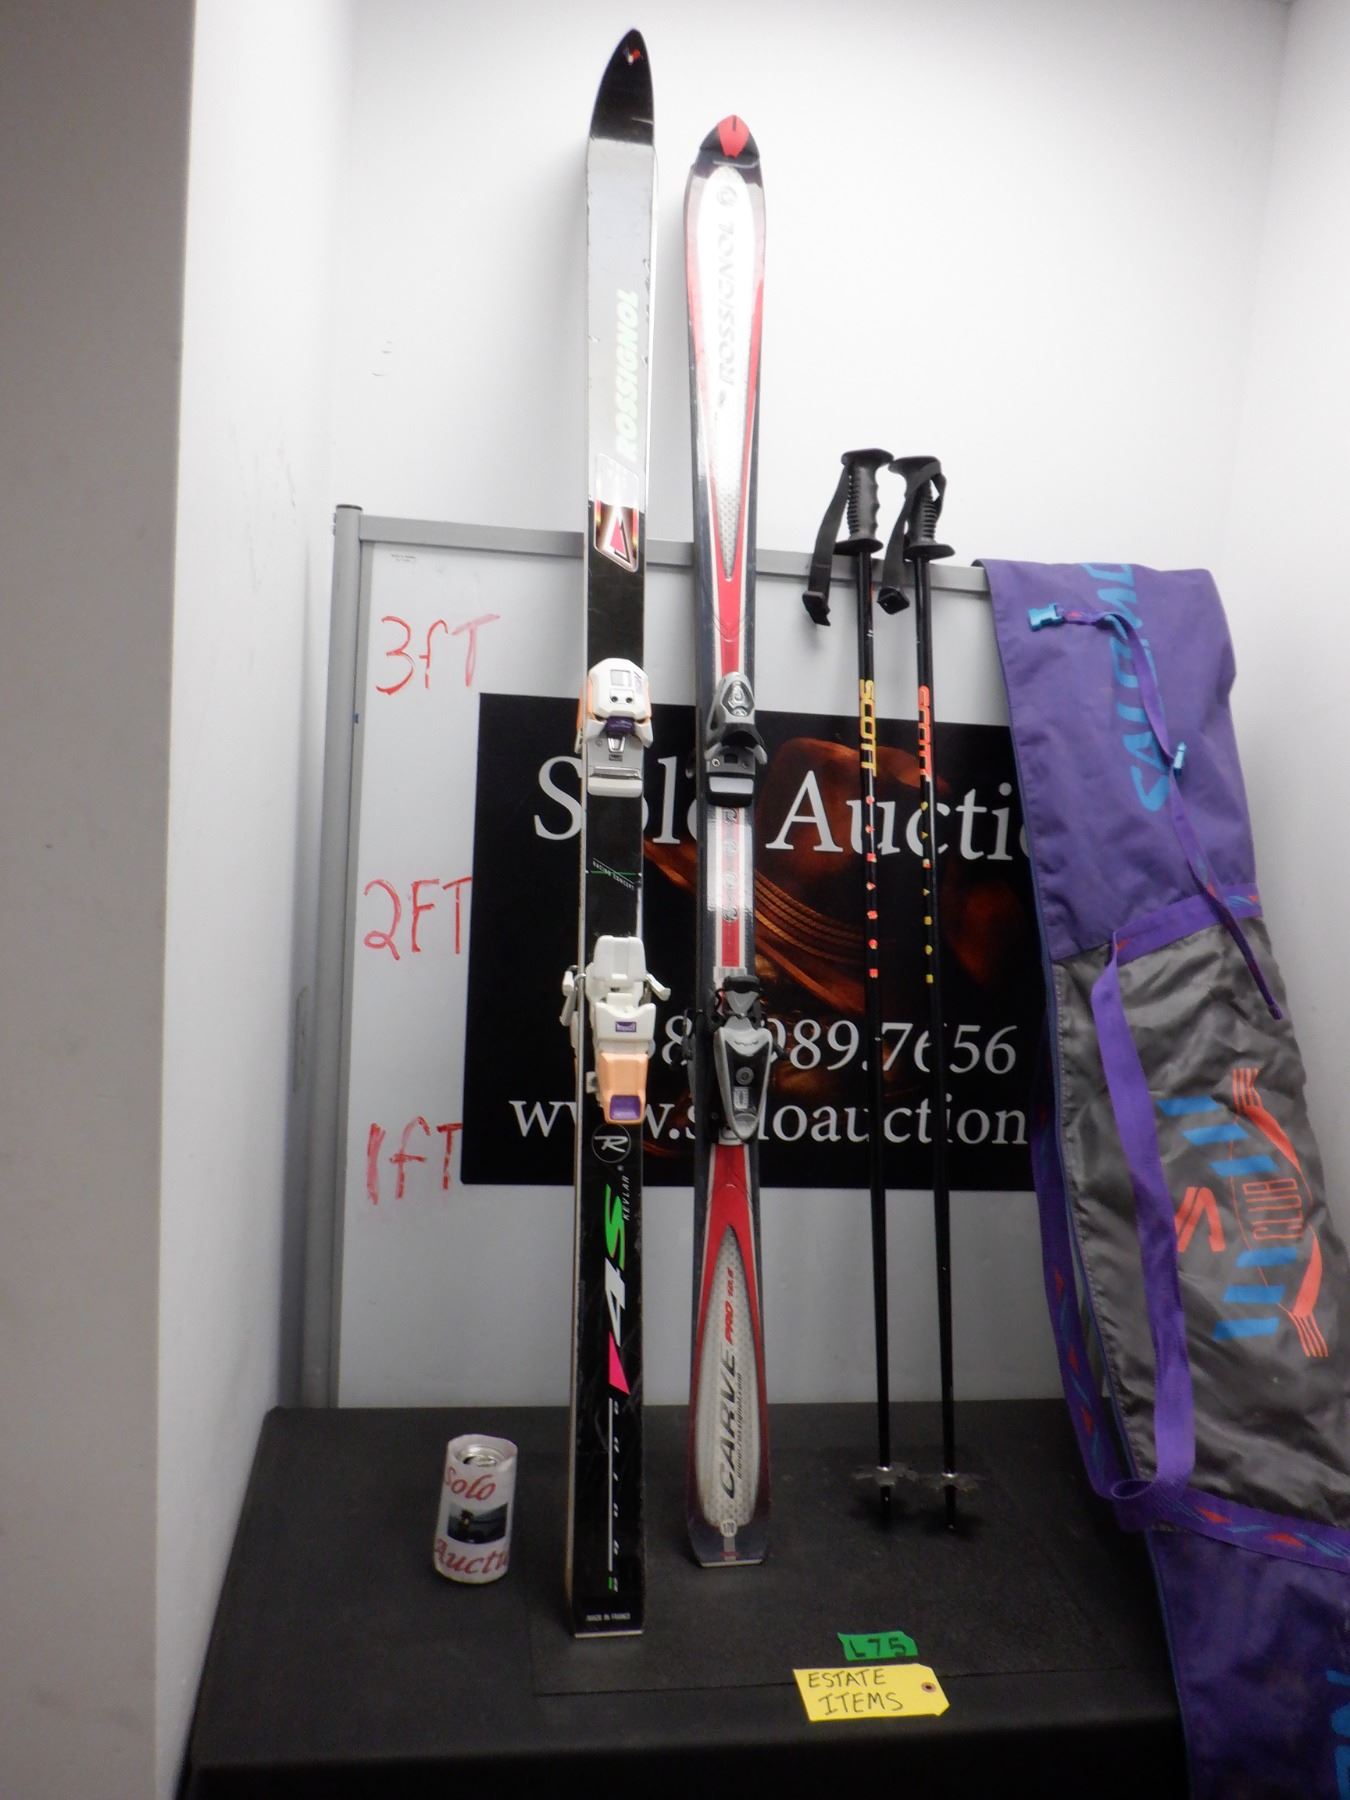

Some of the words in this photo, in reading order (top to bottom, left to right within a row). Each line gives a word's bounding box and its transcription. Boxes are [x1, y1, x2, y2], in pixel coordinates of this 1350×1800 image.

[616, 289, 640, 461] ROSSIGNOL
[859, 679, 877, 777] SCOTT
[363, 876, 472, 961] 2FT
[622, 1174, 630, 1222] KEVLAR
[720, 1344, 737, 1500] CARVE
[808, 1668, 886, 1688] ESTATE
[818, 1692, 903, 1716] ITEMS
